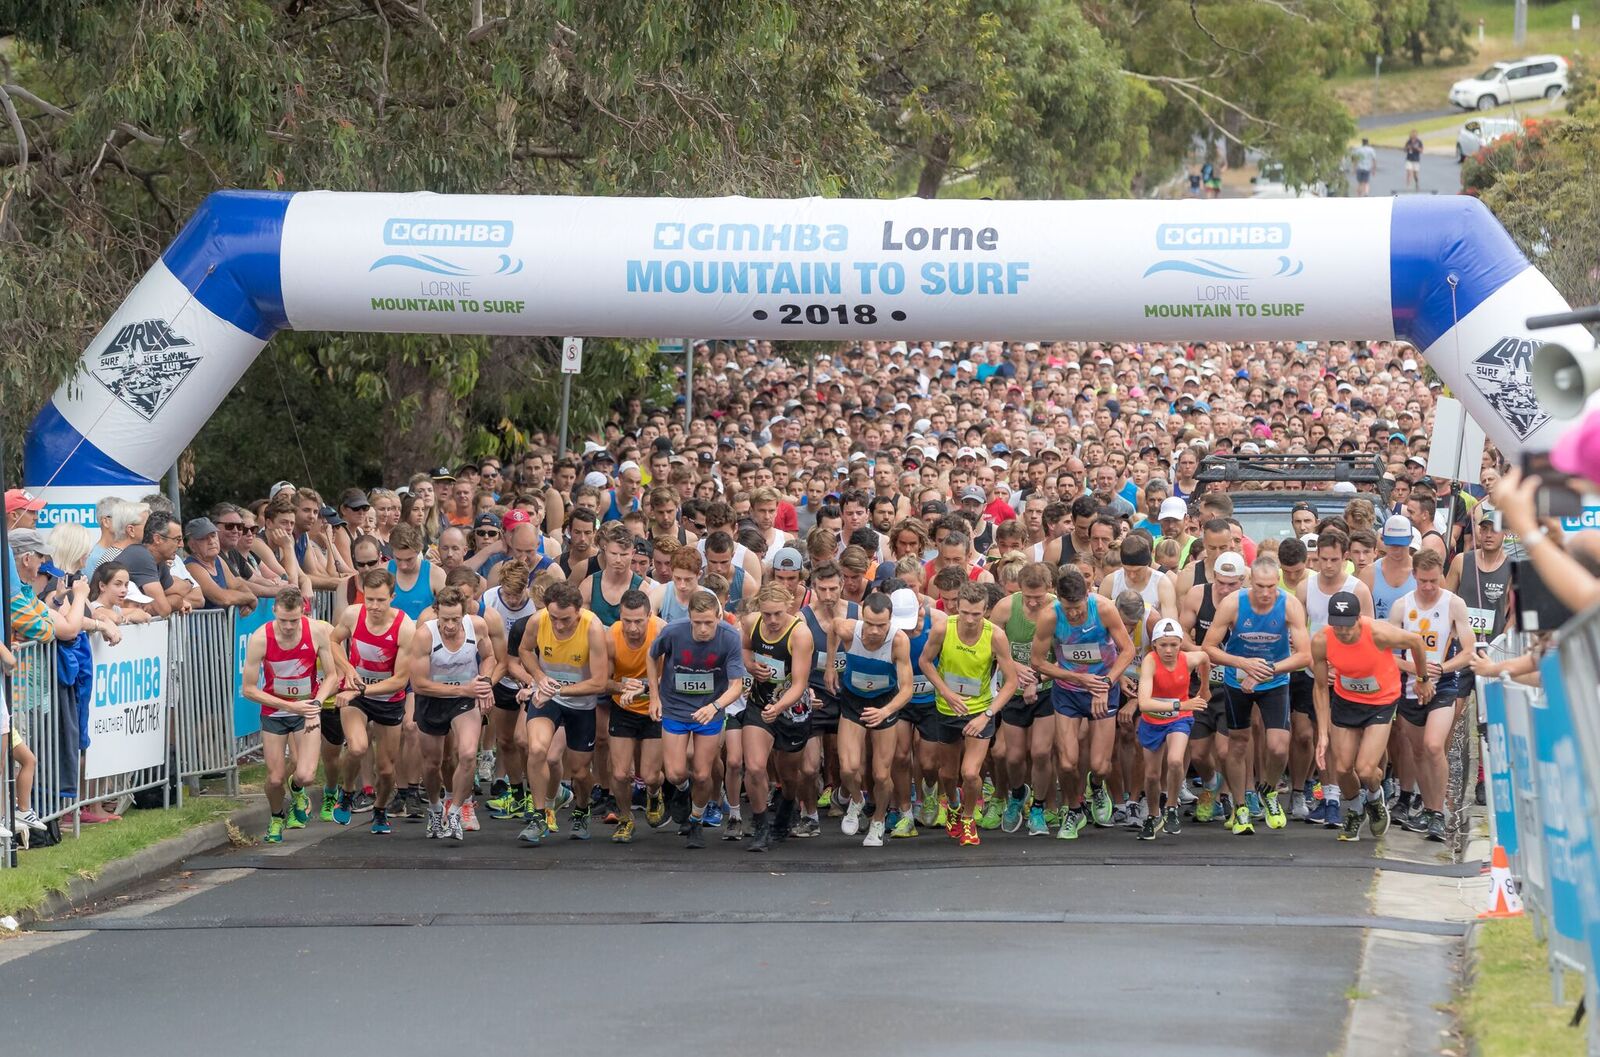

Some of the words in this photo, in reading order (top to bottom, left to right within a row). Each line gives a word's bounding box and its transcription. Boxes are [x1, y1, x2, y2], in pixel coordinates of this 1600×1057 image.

[882, 220, 999, 251] Lorne
[626, 260, 841, 294] MOUNTAIN
[853, 261, 905, 294] TO
[920, 262, 1029, 295] SURF
[420, 281, 472, 297] LORNE
[1196, 285, 1250, 301] LORNE
[371, 297, 455, 311] MOUNTAIN
[459, 299, 480, 313] TO
[483, 300, 525, 313] SURF
[1144, 304, 1232, 317] MOUNTAIN
[1236, 304, 1257, 317] TO
[1261, 303, 1305, 317] SURF
[778, 303, 878, 325] 2018
[100, 320, 192, 356] LORNE
[100, 356, 120, 367] SURF
[161, 361, 181, 371] CLUB
[1476, 366, 1499, 379] SURF
[1072, 650, 1092, 660] 891
[286, 686, 299, 695] 10
[683, 681, 706, 690] 1514
[866, 681, 874, 689] 2
[94, 716, 124, 735] HEALTHIER
[124, 702, 160, 736] TOGETHER
